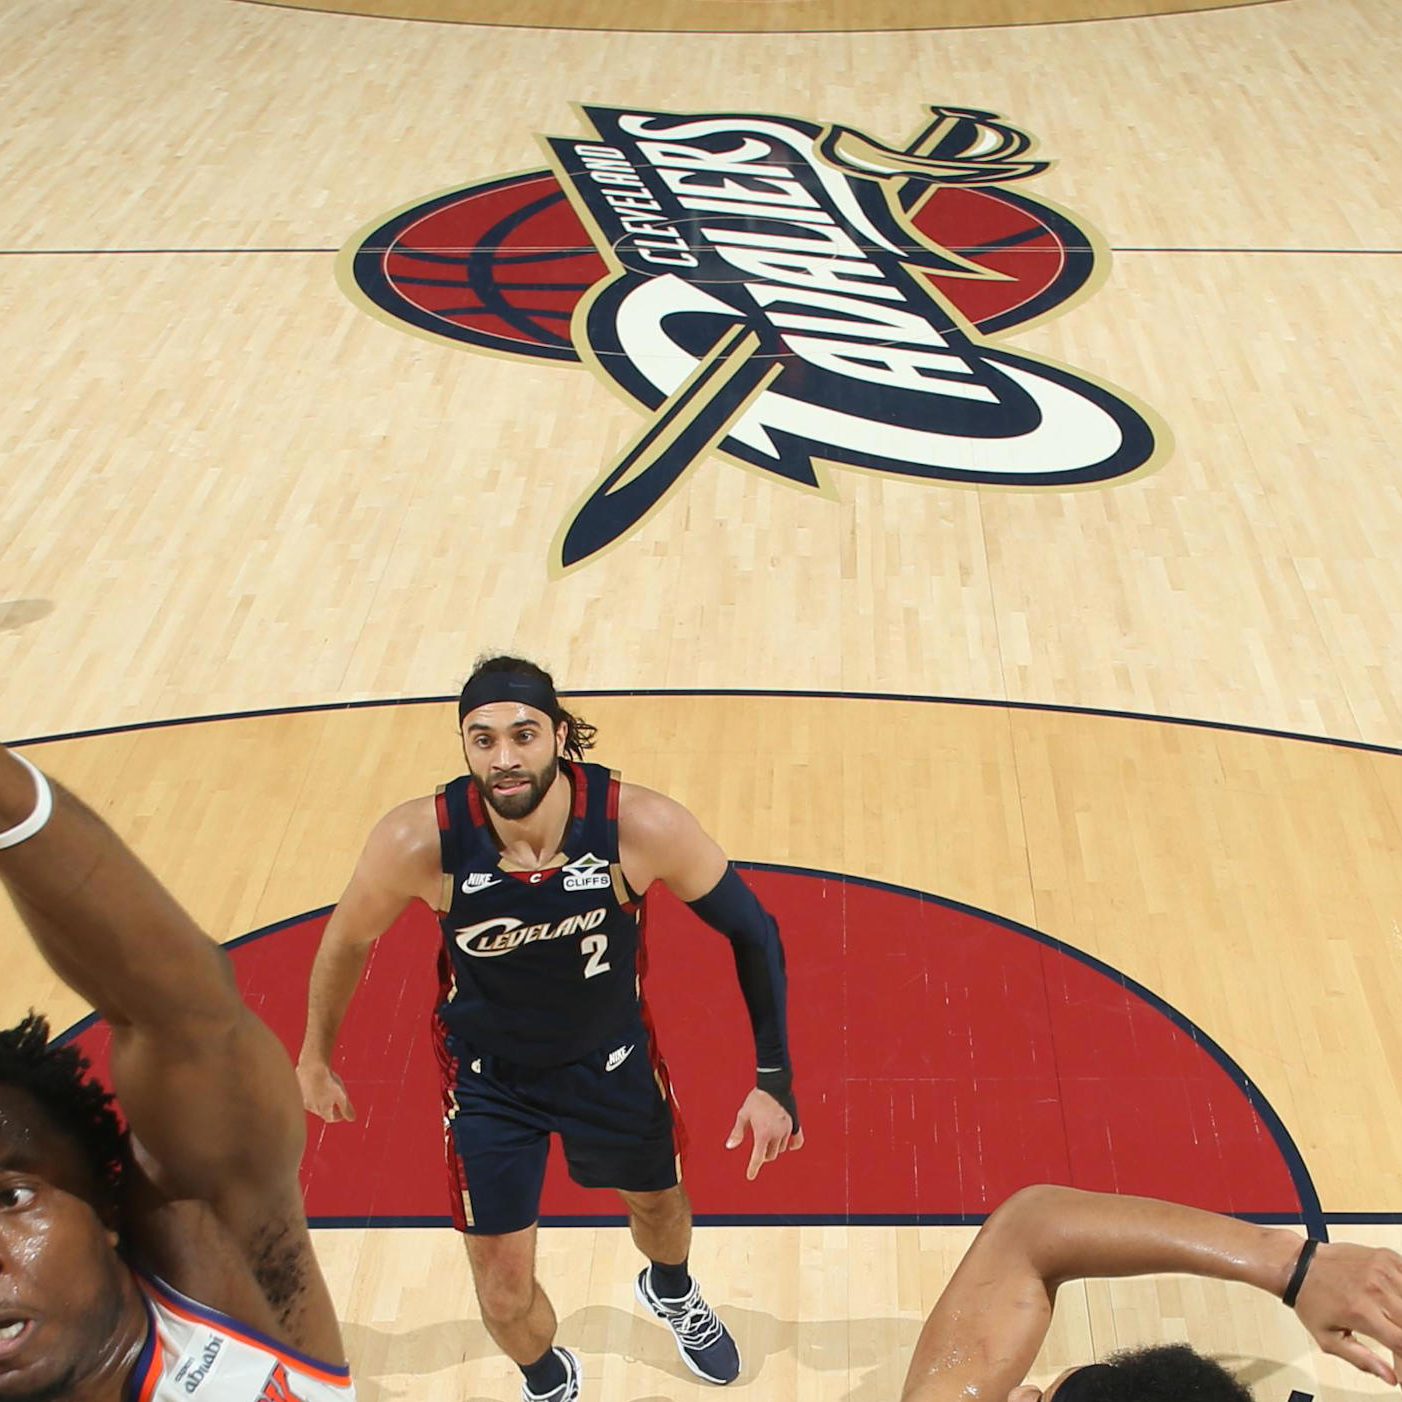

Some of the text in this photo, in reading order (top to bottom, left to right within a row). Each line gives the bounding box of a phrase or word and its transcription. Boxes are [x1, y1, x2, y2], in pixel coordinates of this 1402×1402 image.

[574, 143, 701, 268] CLEVELAND
[615, 113, 1124, 476] CAVALIERS
[565, 876, 609, 888] CLIFFS
[454, 907, 608, 958] CLEVELAND
[580, 933, 612, 980] 2
